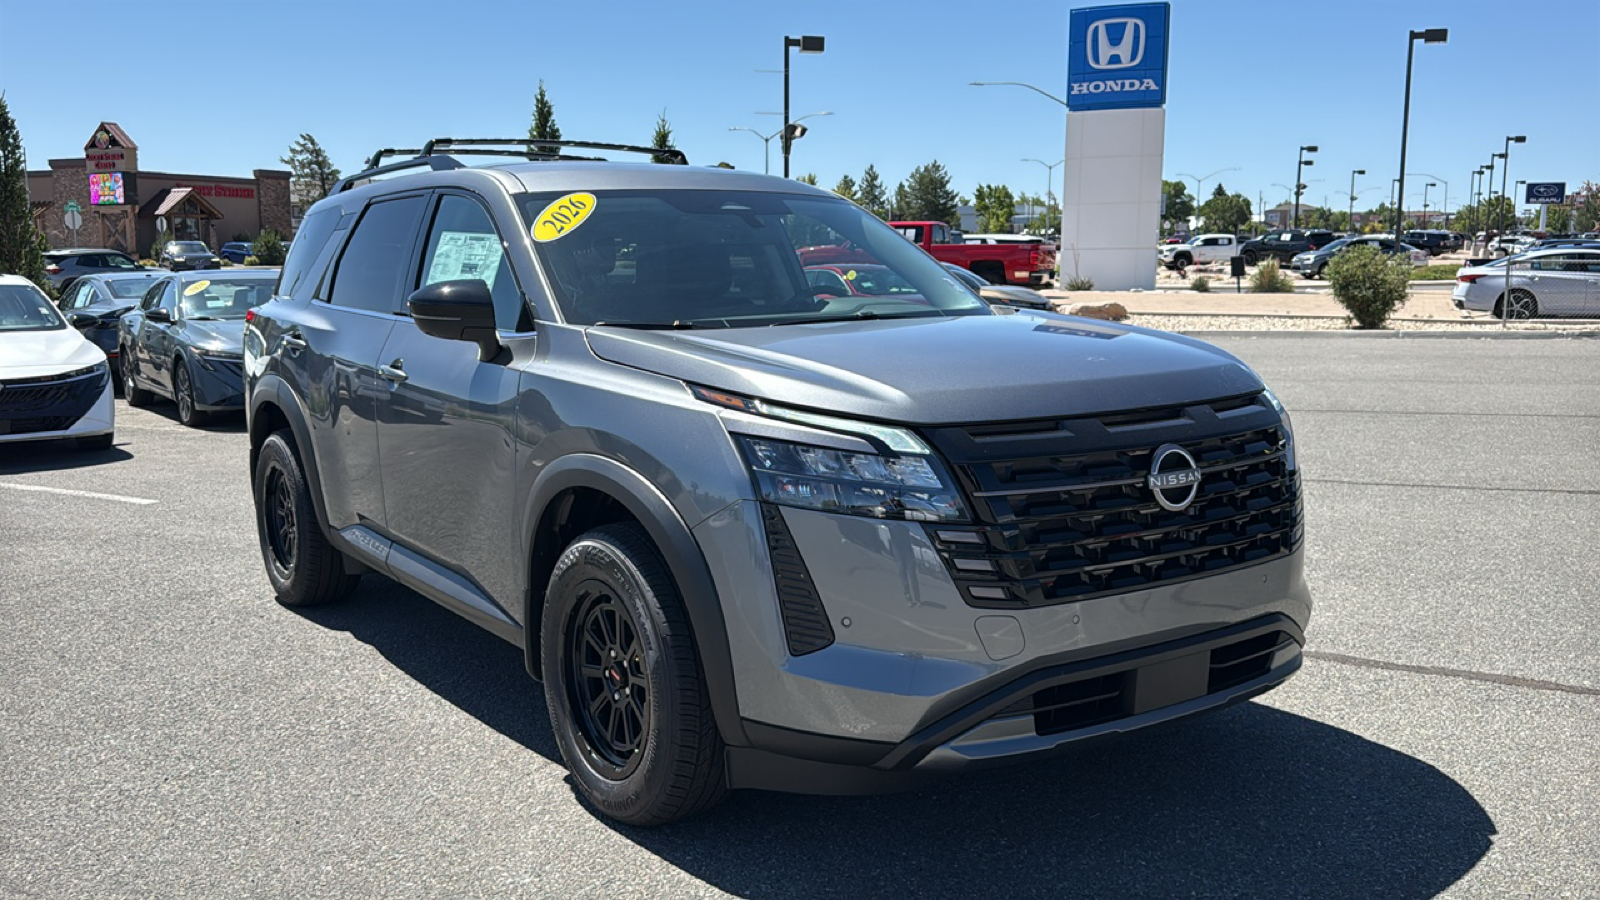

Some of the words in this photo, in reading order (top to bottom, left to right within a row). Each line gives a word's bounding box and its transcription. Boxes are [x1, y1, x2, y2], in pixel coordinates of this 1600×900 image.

[1071, 79, 1159, 95] HONDA
[542, 196, 586, 234] 2026
[1151, 470, 1200, 486] NISSAN
